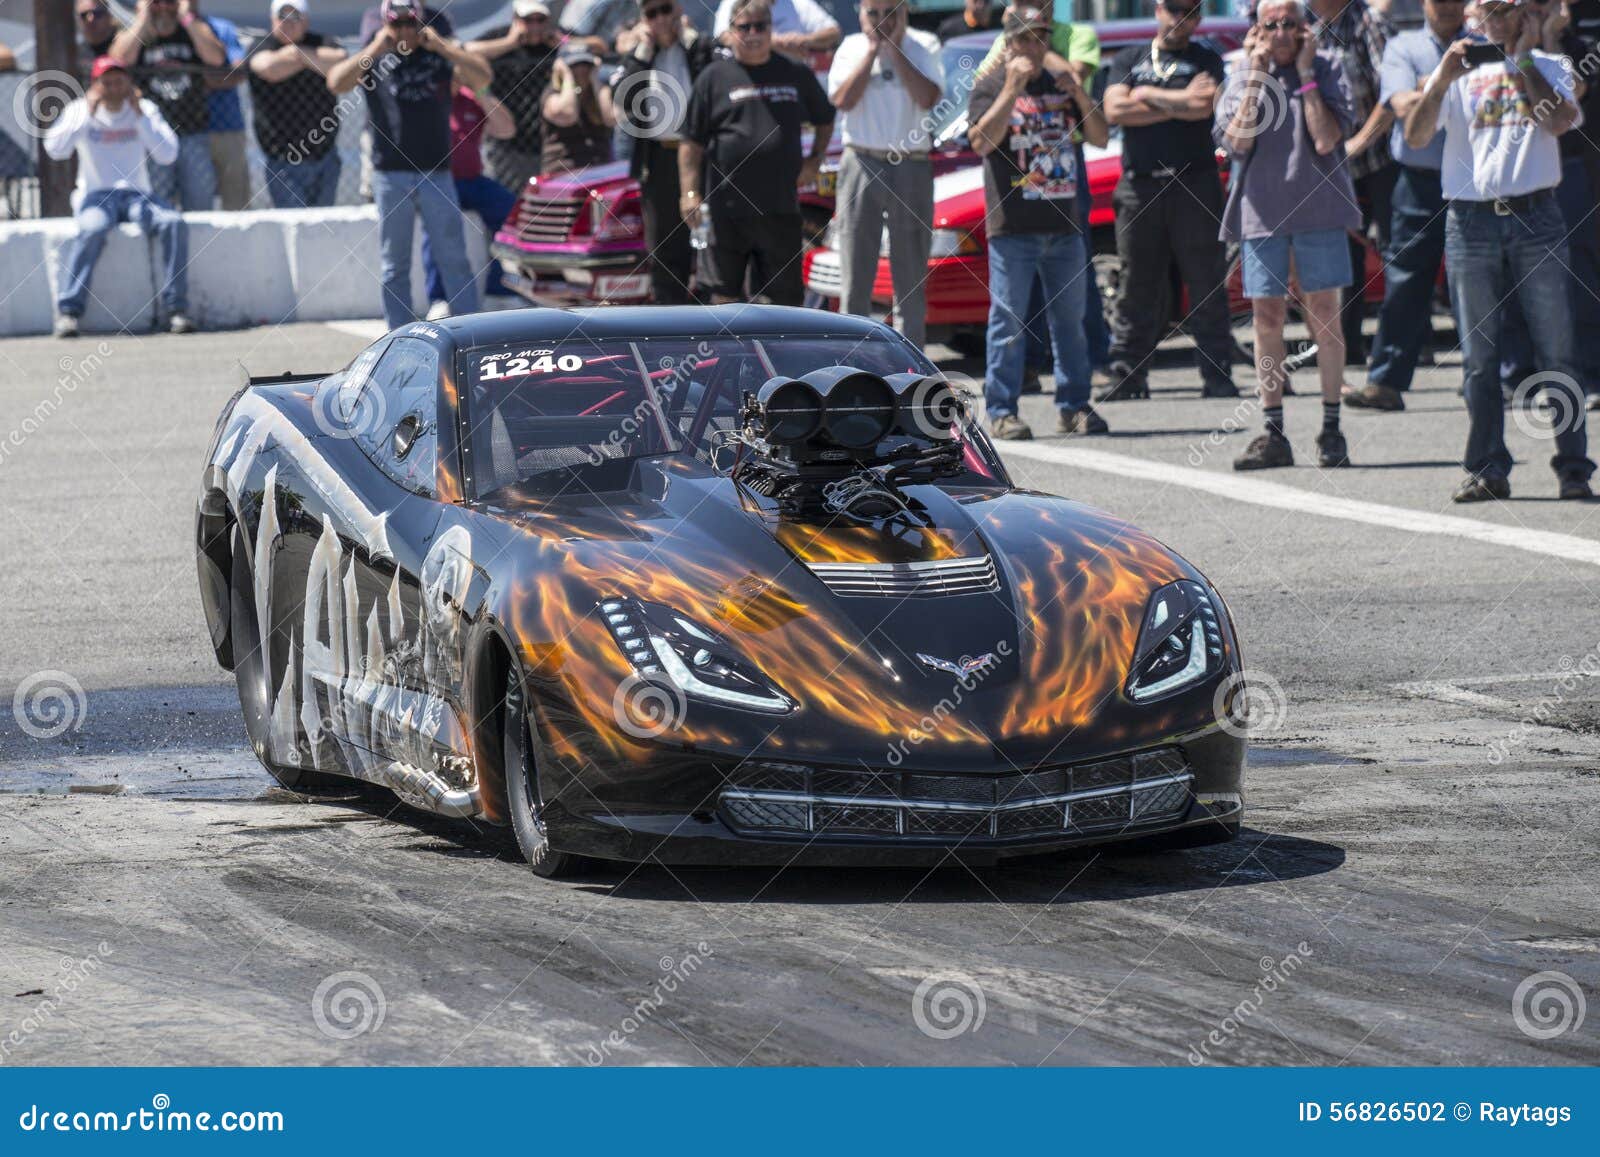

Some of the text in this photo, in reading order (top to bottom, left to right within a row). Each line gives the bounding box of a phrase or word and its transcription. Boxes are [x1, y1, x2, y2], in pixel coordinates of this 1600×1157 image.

[480, 349, 554, 363] PRO MOD
[480, 354, 583, 381] 1240
